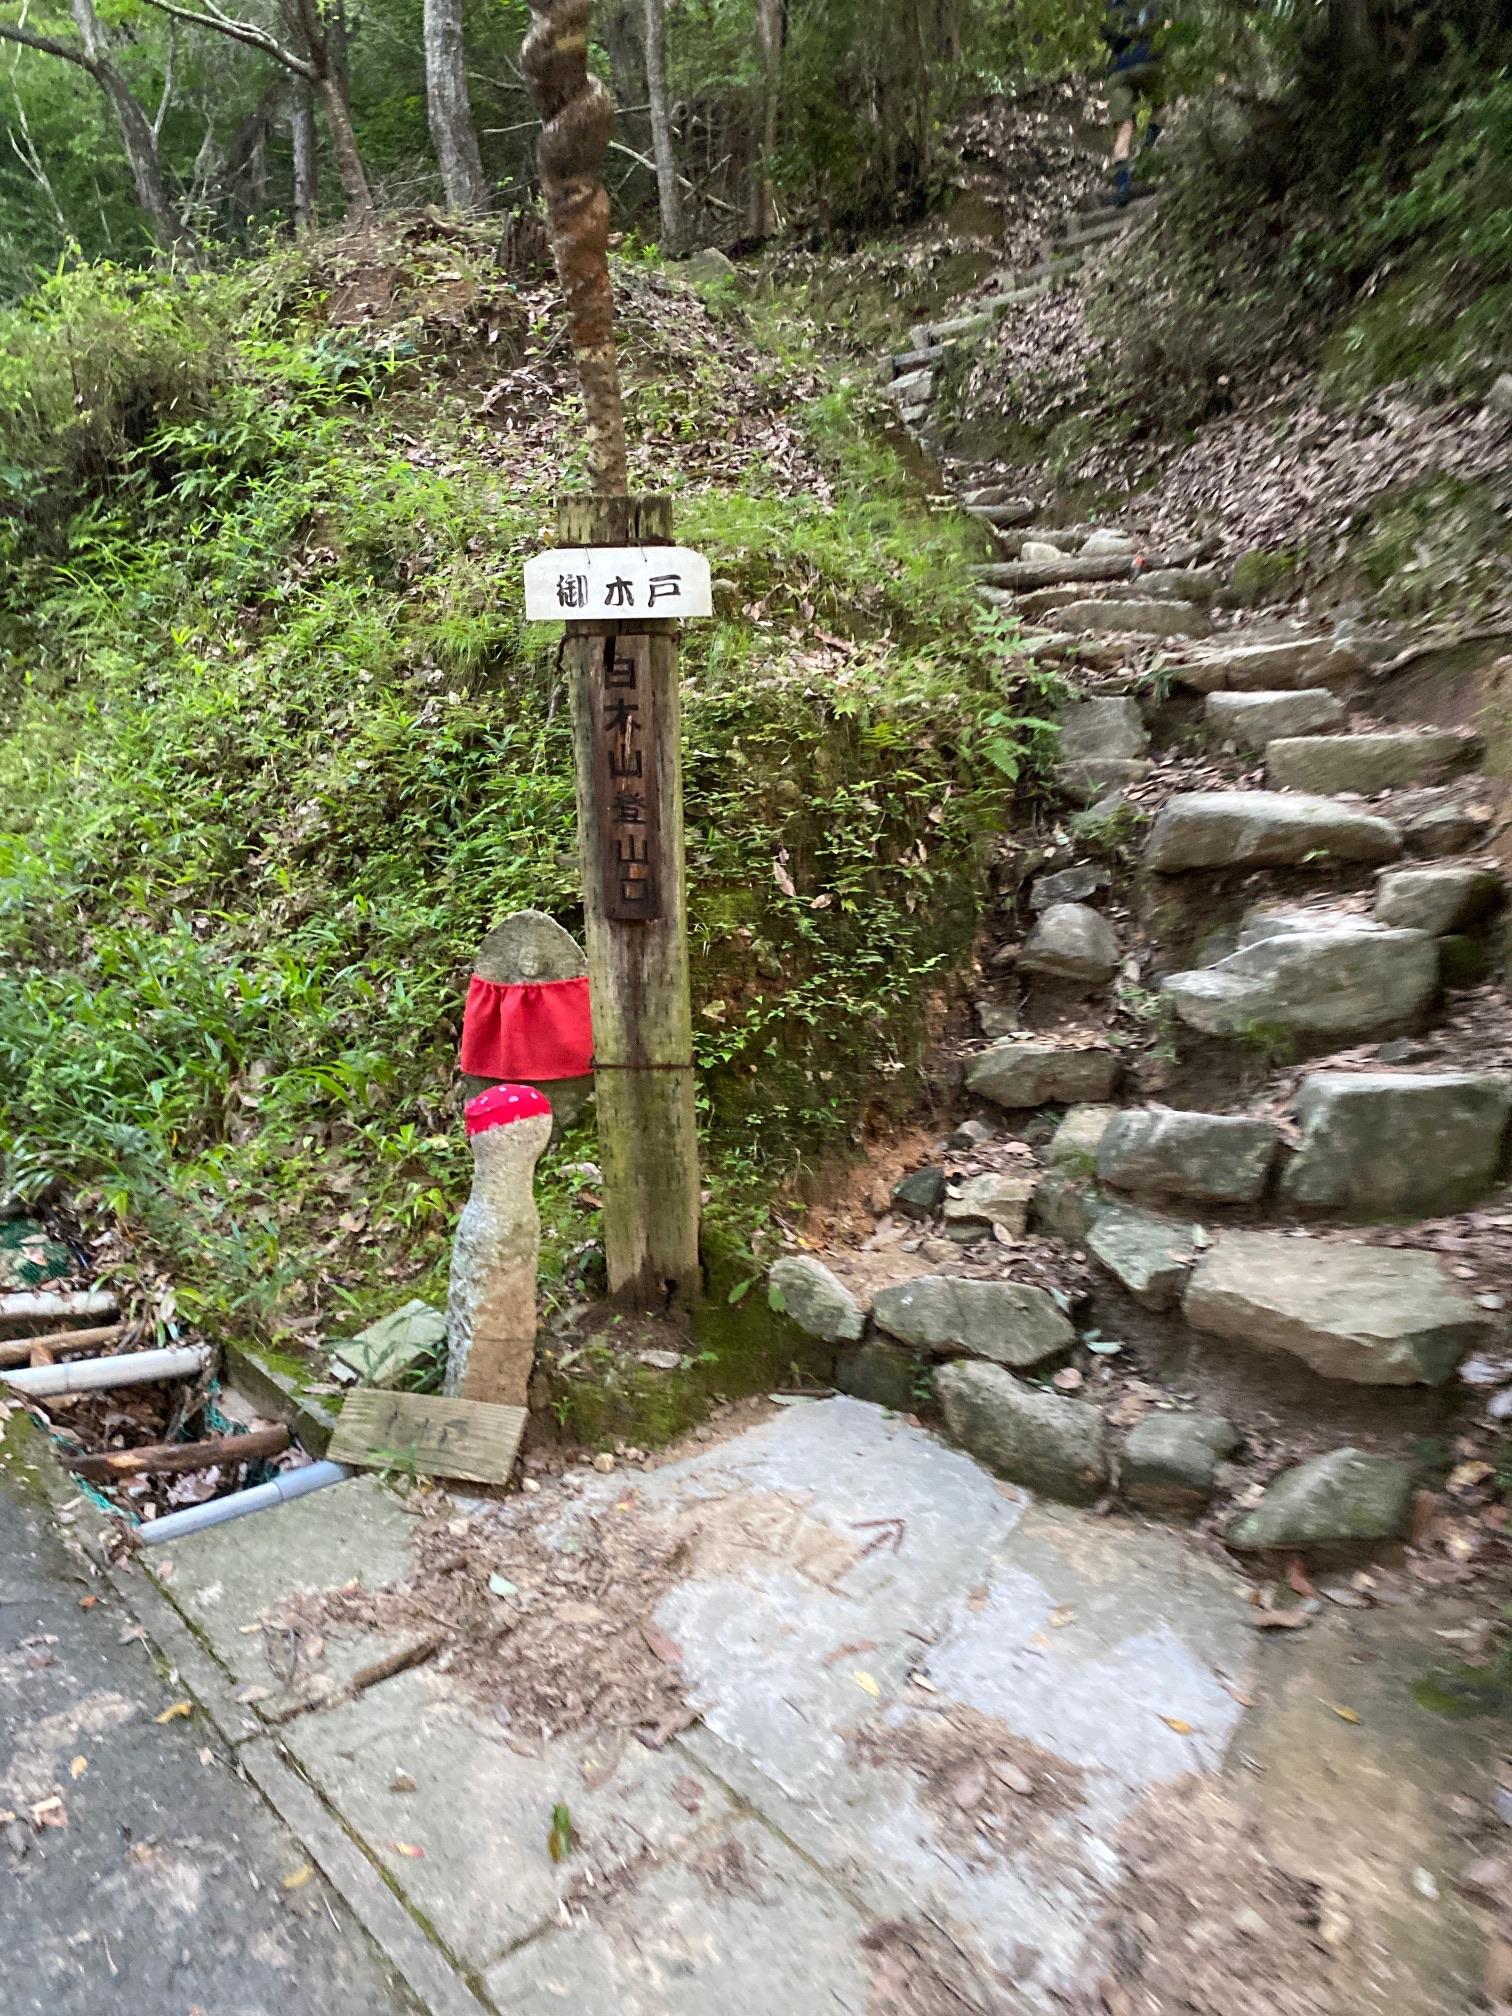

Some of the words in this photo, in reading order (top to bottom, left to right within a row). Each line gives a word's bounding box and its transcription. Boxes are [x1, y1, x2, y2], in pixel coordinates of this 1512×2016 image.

[556, 574, 682, 608] 御木戸
[602, 656, 650, 905] 白木山登山口
